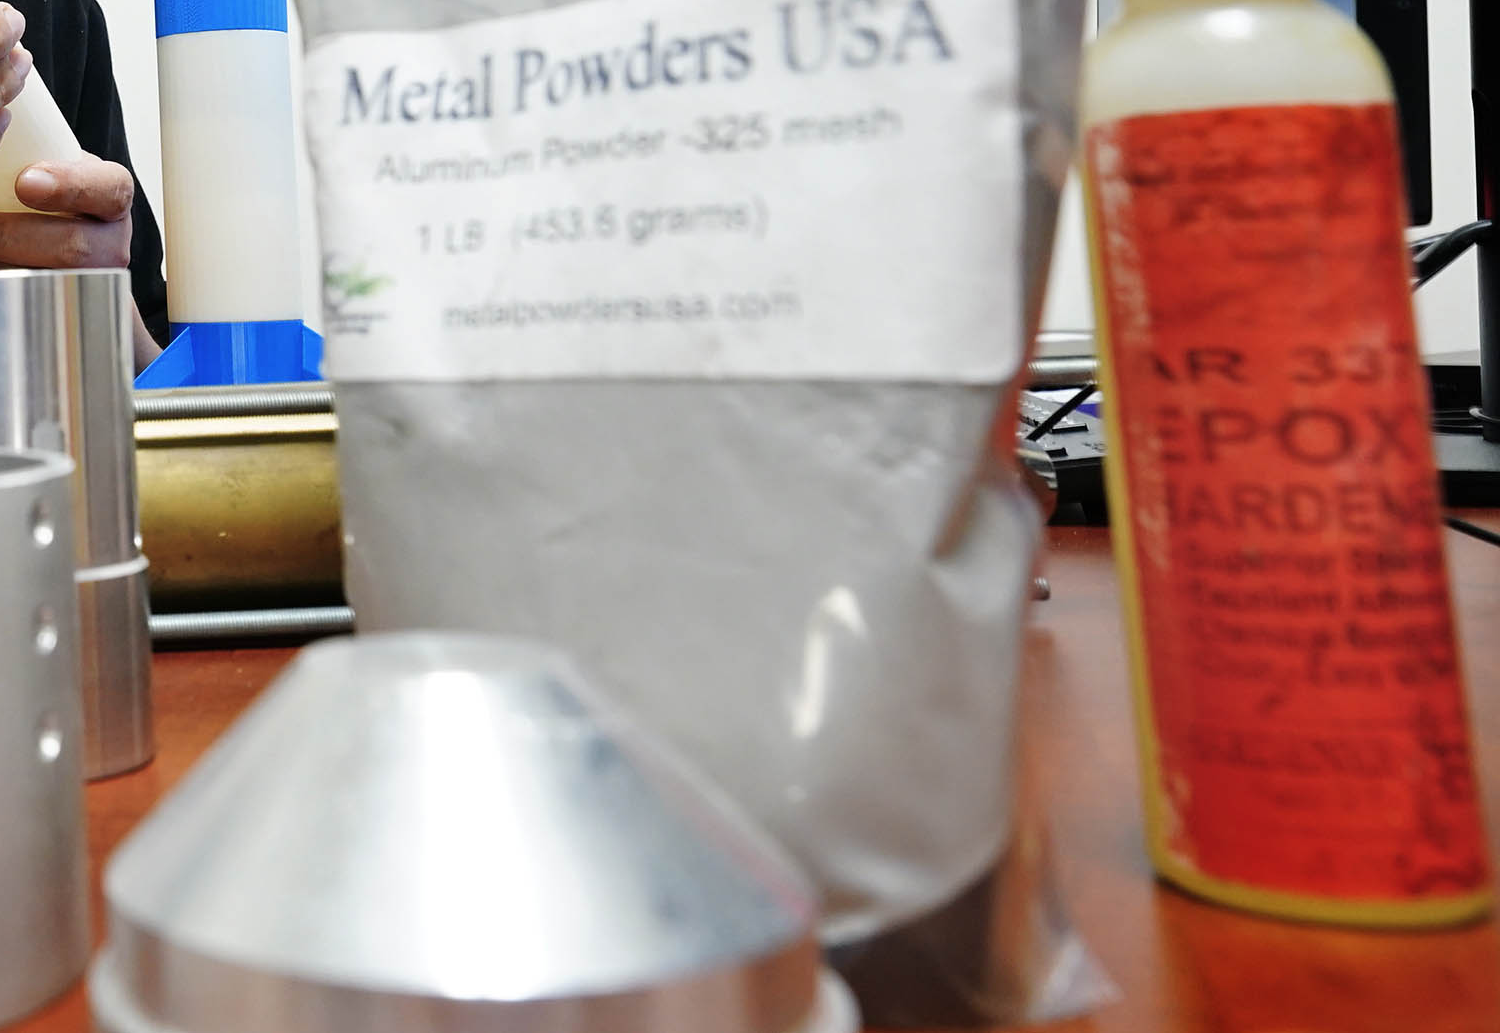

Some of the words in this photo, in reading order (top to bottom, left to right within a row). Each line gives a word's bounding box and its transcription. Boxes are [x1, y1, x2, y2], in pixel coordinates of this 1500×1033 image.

[340, 57, 494, 125] Metal
[514, 22, 753, 113] Powders
[376, 147, 535, 183] Aluminum
[544, 128, 666, 166] Powder
[680, 111, 769, 154] -325
[784, 106, 903, 144] mesh
[417, 224, 430, 254] 1
[445, 221, 485, 254] LB
[628, 195, 769, 246] grams)
[443, 289, 802, 330] metalpowdersusa.com
